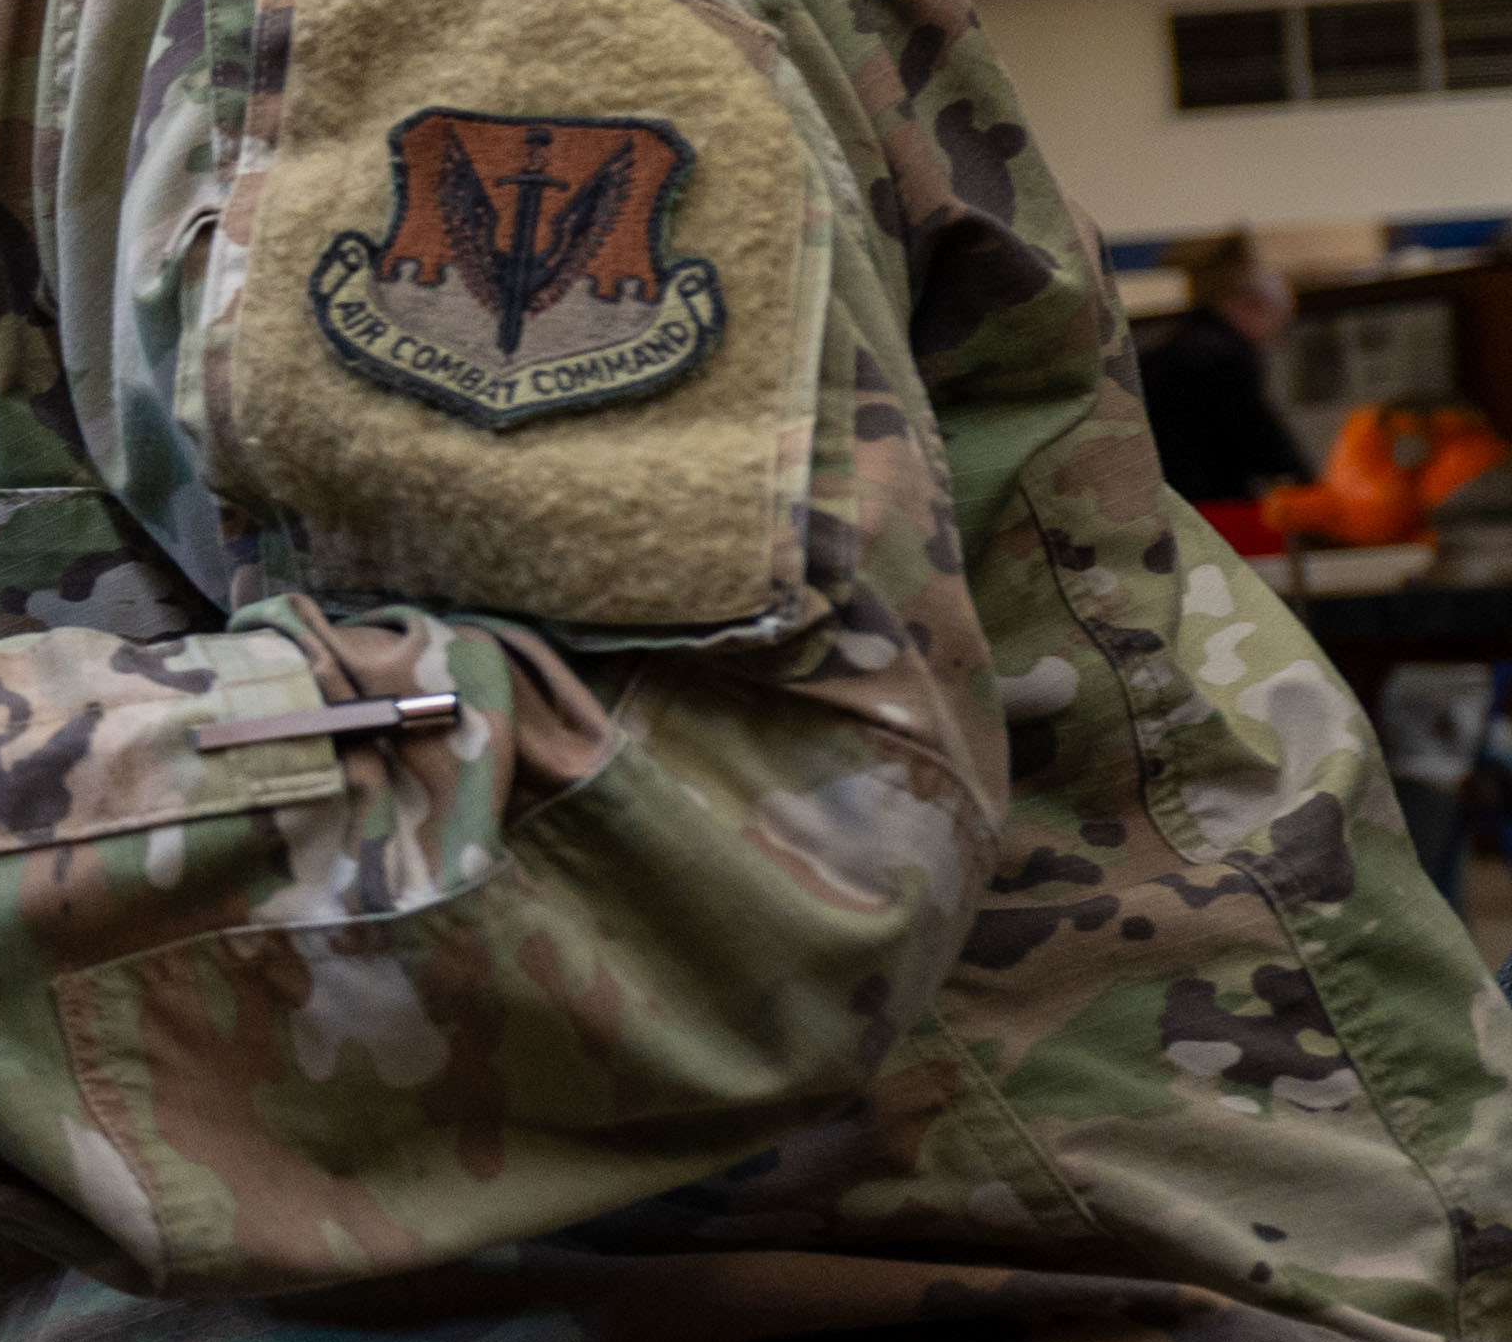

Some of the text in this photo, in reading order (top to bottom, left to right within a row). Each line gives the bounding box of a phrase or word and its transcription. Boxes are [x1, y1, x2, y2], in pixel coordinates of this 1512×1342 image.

[336, 299, 690, 405] AIR COMBAT COMMAND
